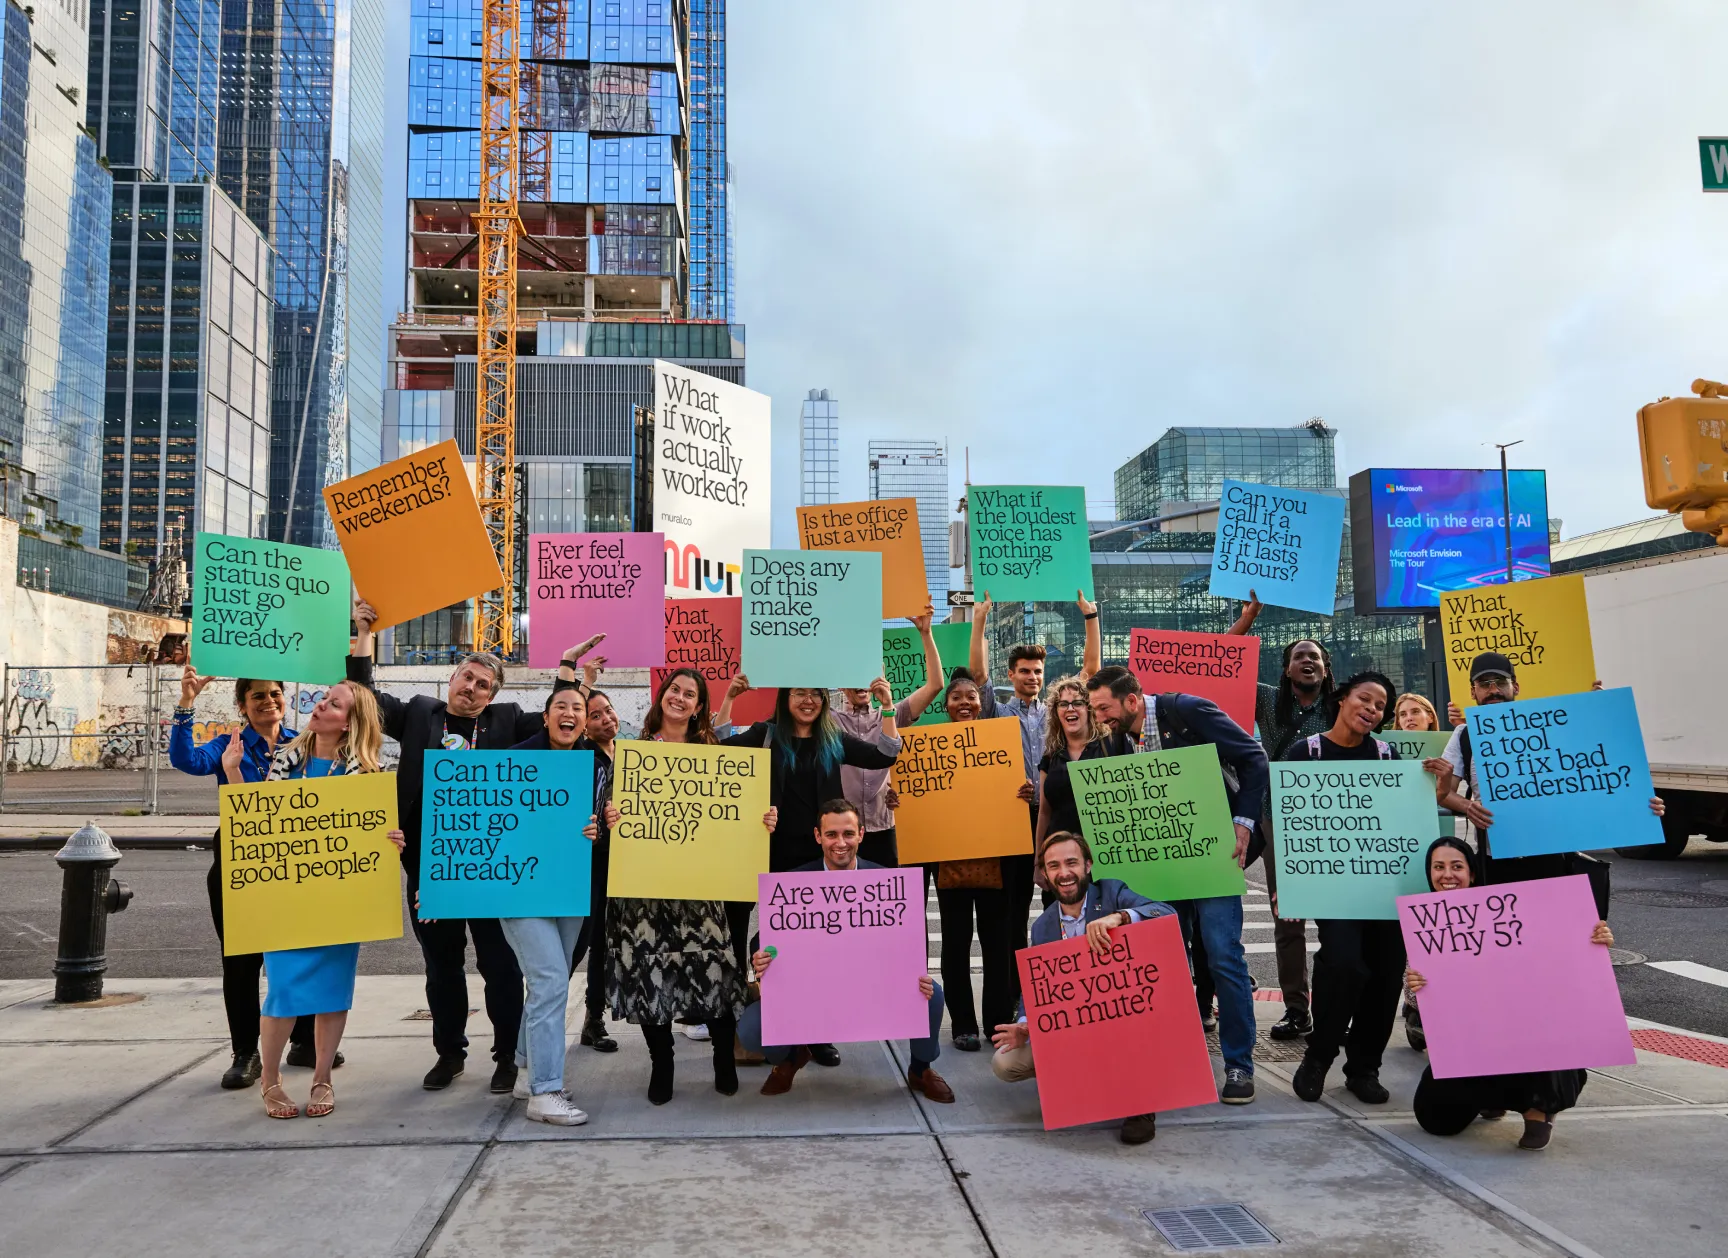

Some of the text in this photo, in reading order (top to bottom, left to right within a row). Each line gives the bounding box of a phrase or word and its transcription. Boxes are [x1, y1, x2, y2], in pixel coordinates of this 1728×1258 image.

[662, 373, 719, 414] What
[663, 404, 732, 446] if work
[663, 438, 743, 478] actually
[331, 456, 447, 515] Remember
[662, 468, 748, 507] worked?
[338, 475, 452, 535] weekends?
[974, 491, 1043, 508] What if
[1227, 487, 1307, 515] Can you
[661, 512, 692, 526] mural.co
[802, 505, 908, 530] Is the office
[975, 507, 1076, 525] the loudest
[1225, 504, 1290, 529] call it a
[1387, 513, 1421, 527] Lead
[1426, 513, 1439, 527] in
[1443, 514, 1467, 527] the
[1471, 516, 1494, 527] era
[1516, 513, 1531, 527] AI
[804, 522, 903, 550] just a vibe?
[977, 524, 1062, 542] voice has
[1222, 520, 1302, 548] check-in
[205, 541, 302, 571] Can the
[537, 539, 625, 560] Ever feel
[978, 542, 1053, 562] nothing
[1220, 537, 1298, 565] if it lasts
[1389, 549, 1462, 557] Microsoft Envision
[537, 560, 641, 583] like you're
[664, 540, 743, 596] mur
[750, 556, 850, 581] Does any
[979, 559, 1041, 579] to say?
[1217, 554, 1298, 582] 3 hours?
[1389, 559, 1425, 567] The Tour
[204, 563, 330, 596] status quo
[537, 579, 635, 599] on mute?
[750, 576, 818, 596] of this
[203, 582, 285, 611] just go
[750, 597, 813, 616] make
[1445, 594, 1507, 615] What
[202, 607, 269, 630] away
[750, 617, 821, 637] sense?
[1448, 608, 1524, 635] if work
[202, 624, 303, 654] already?
[672, 623, 724, 644] work
[883, 637, 911, 651] oes
[1452, 627, 1538, 653] actually
[665, 642, 735, 664] ctually
[1136, 635, 1246, 660] Remember
[1452, 645, 1545, 671] wed?
[656, 661, 740, 682] wed?
[883, 652, 927, 671] nyon
[1135, 656, 1243, 678] weekends?
[885, 665, 916, 686] ally
[1473, 707, 1569, 736] Is there
[954, 727, 977, 749] all
[1479, 728, 1551, 757] a tool
[434, 758, 538, 783] Can the
[622, 749, 756, 778] Do you feel
[895, 746, 1012, 775] adults here,
[1078, 758, 1181, 786] What's the
[1482, 744, 1609, 780] to fix bad
[621, 770, 742, 801] like you're
[897, 771, 955, 797] right?
[1279, 769, 1403, 793] Do you ever
[1486, 765, 1631, 802] leadership?
[228, 787, 319, 816] Why do
[433, 785, 569, 811] status quo
[1084, 782, 1168, 807] emoji for
[1281, 789, 1373, 814] go to the
[229, 808, 386, 838] bad meetings
[432, 809, 519, 836] just go
[620, 798, 741, 822] always on
[1128, 799, 1198, 826] project
[1282, 813, 1382, 832] restroom
[618, 817, 699, 845] call(s)?
[1093, 819, 1194, 846] is officially
[230, 835, 348, 863] happen to
[431, 837, 501, 861] away
[1097, 844, 1121, 865] off
[1124, 841, 1159, 863] the
[1283, 834, 1419, 857] just to waste
[230, 851, 380, 889] good people?
[430, 856, 539, 885] already?
[1284, 854, 1410, 876] some time?
[768, 876, 907, 906] Are we still
[769, 901, 907, 934] doing this?
[1408, 893, 1518, 929] Why 9?
[1413, 920, 1524, 955] Why 5?
[1027, 951, 1082, 981] Ever
[1033, 963, 1159, 1008] like you're
[1037, 986, 1154, 1033] on mute?
